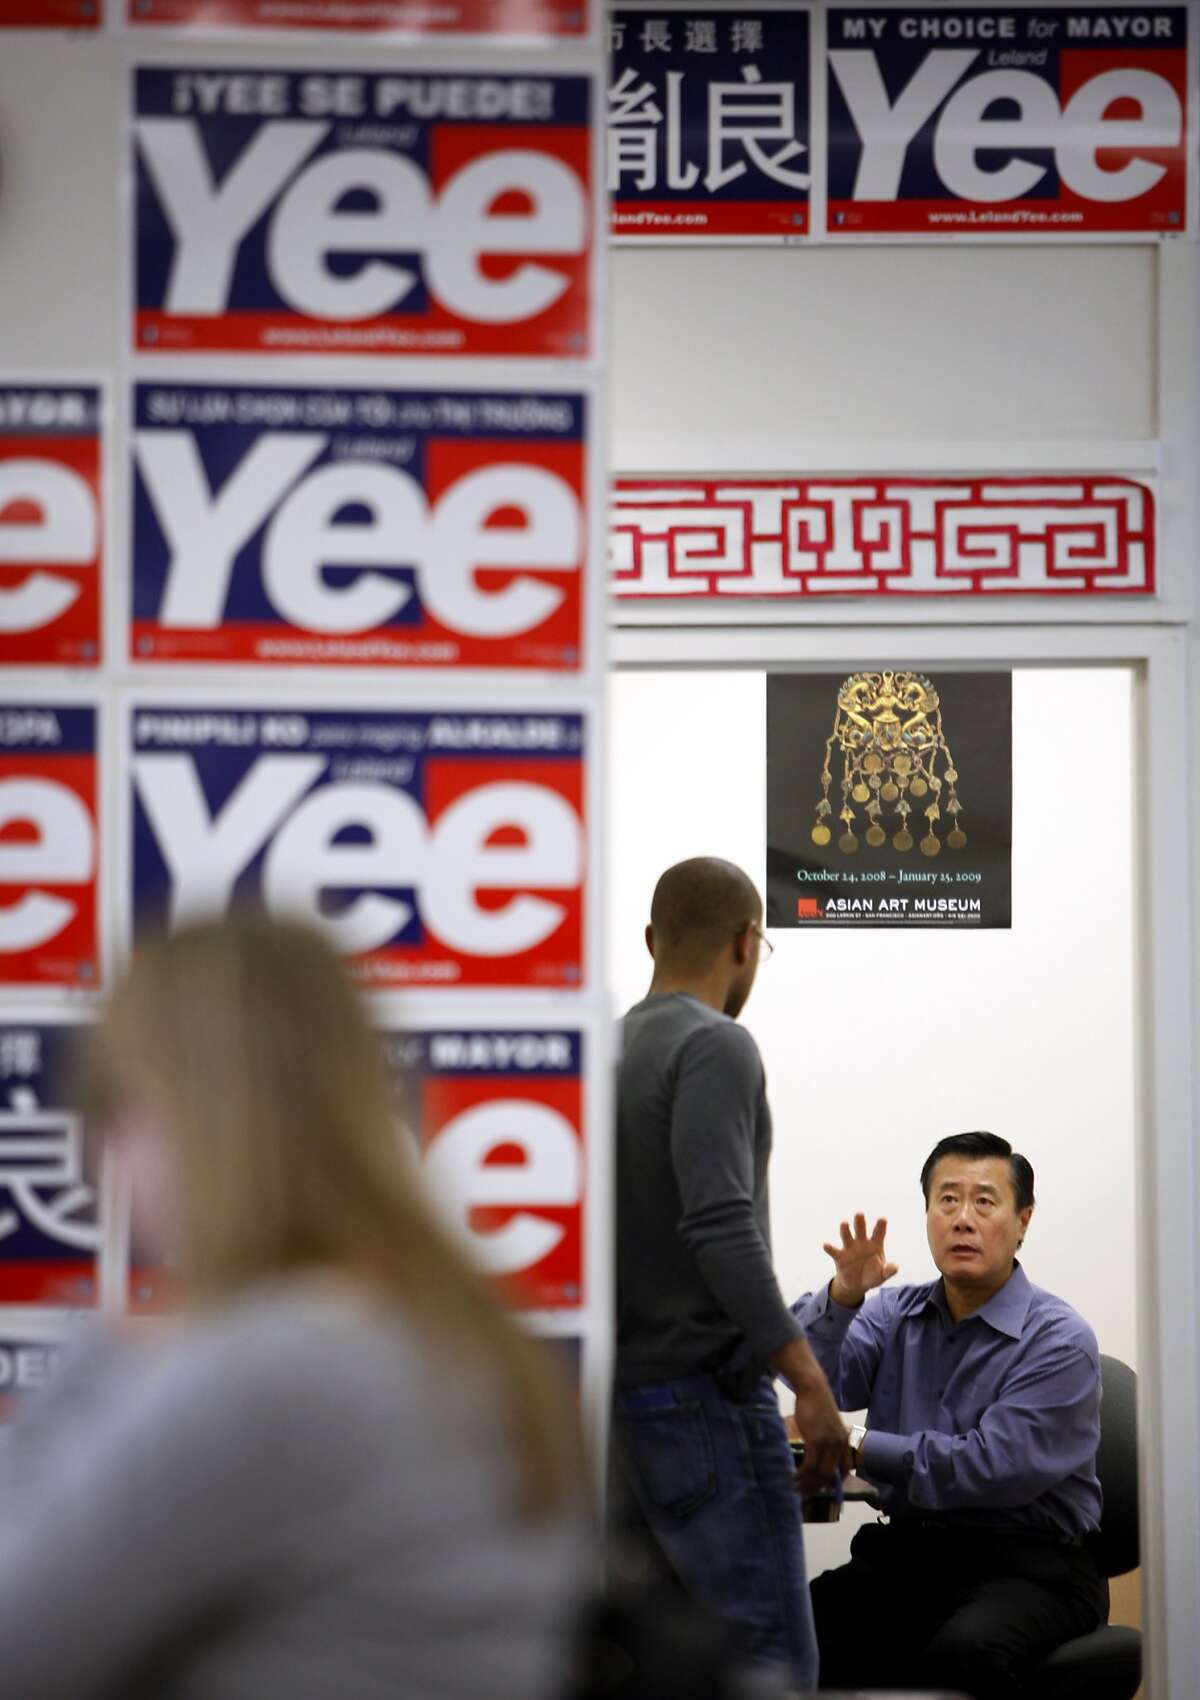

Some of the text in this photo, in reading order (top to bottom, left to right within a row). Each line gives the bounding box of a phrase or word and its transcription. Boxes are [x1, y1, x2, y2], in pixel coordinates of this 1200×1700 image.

[843, 17, 1174, 39] MY CHOICE for MAYOR
[988, 49, 1047, 66] Leland
[298, 76, 365, 116] SE
[375, 77, 554, 120] PUEDE!
[608, 63, 811, 193] 胤良
[828, 49, 1184, 203] Yee
[135, 119, 588, 325] Yee
[613, 211, 708, 225] landYee.com
[927, 210, 1084, 224] www.LelandYee.com
[132, 430, 583, 638] Yee
[132, 751, 584, 958] Yee
[797, 868, 840, 882] October
[842, 871, 858, 884] 24,
[861, 869, 887, 882] 2008
[897, 868, 938, 885] January
[940, 871, 953, 884] 25,
[956, 871, 982, 883] 2009
[826, 898, 981, 911] ASIAN ART MUSEUM
[428, 1033, 574, 1069] MAYOR
